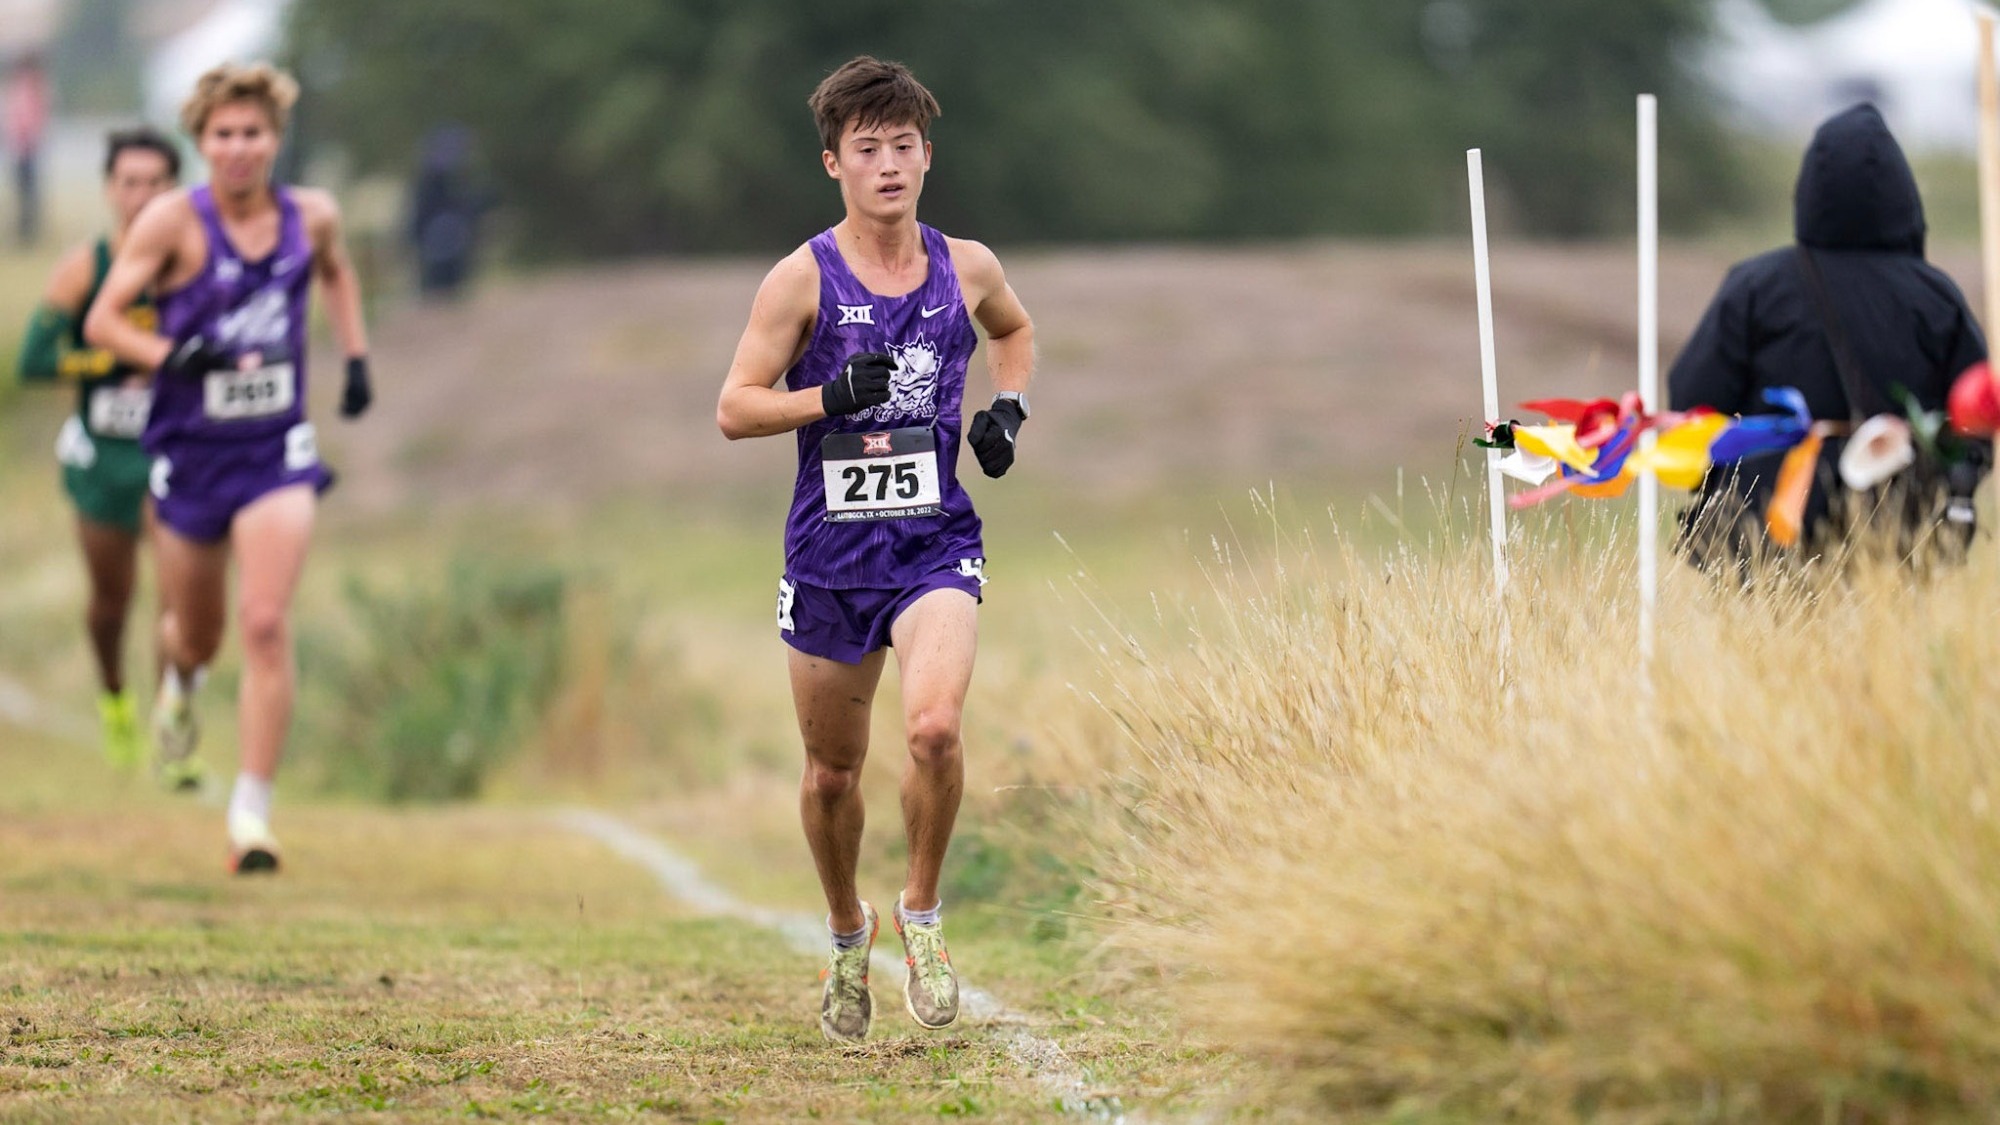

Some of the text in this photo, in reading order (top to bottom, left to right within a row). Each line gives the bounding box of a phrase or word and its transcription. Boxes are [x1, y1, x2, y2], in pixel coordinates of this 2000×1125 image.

[837, 304, 875, 326] XII
[867, 438, 888, 450] XII
[842, 462, 919, 502] 275
[866, 510, 875, 519] TX
[879, 508, 906, 518] OCTOBER
[917, 506, 932, 515] 2022
